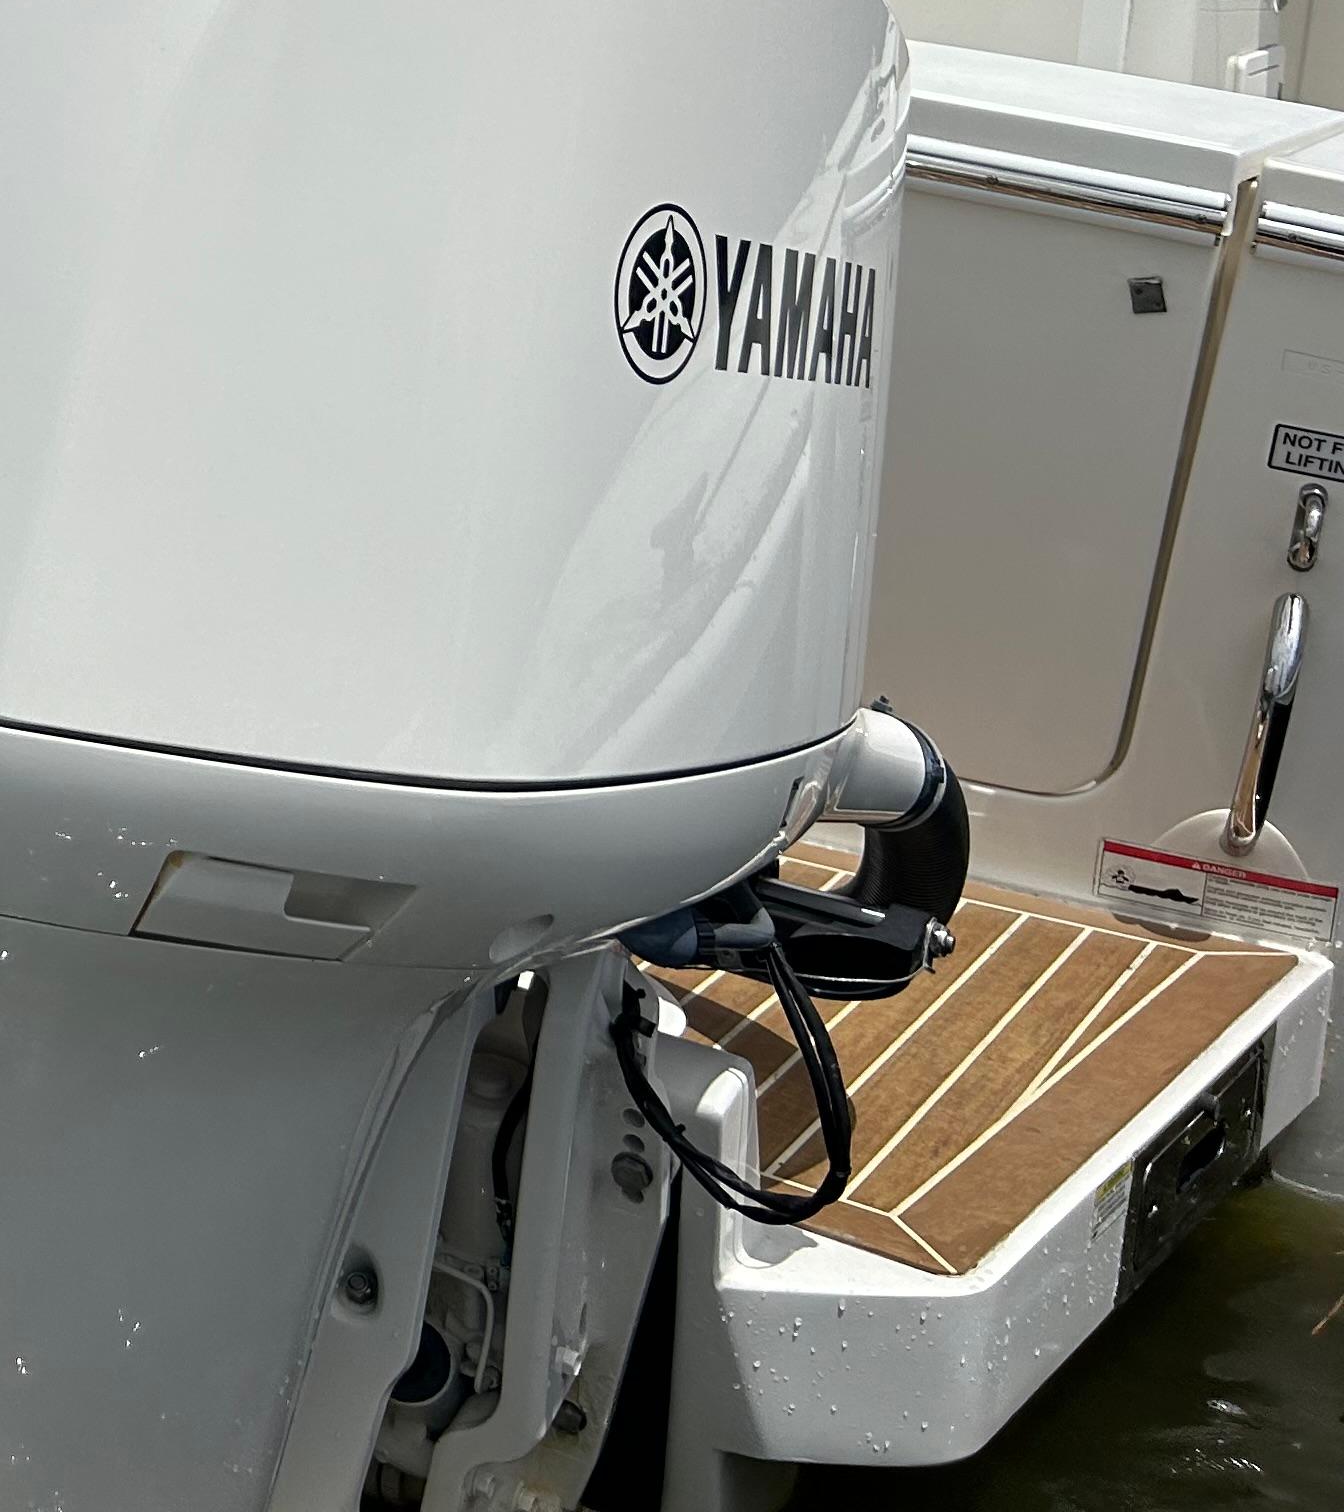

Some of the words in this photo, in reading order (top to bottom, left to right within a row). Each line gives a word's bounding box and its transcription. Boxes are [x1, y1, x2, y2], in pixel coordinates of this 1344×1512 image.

[715, 234, 876, 389] YAMAHA
[1282, 431, 1328, 452] NOT
[1202, 862, 1247, 879] DANGER
